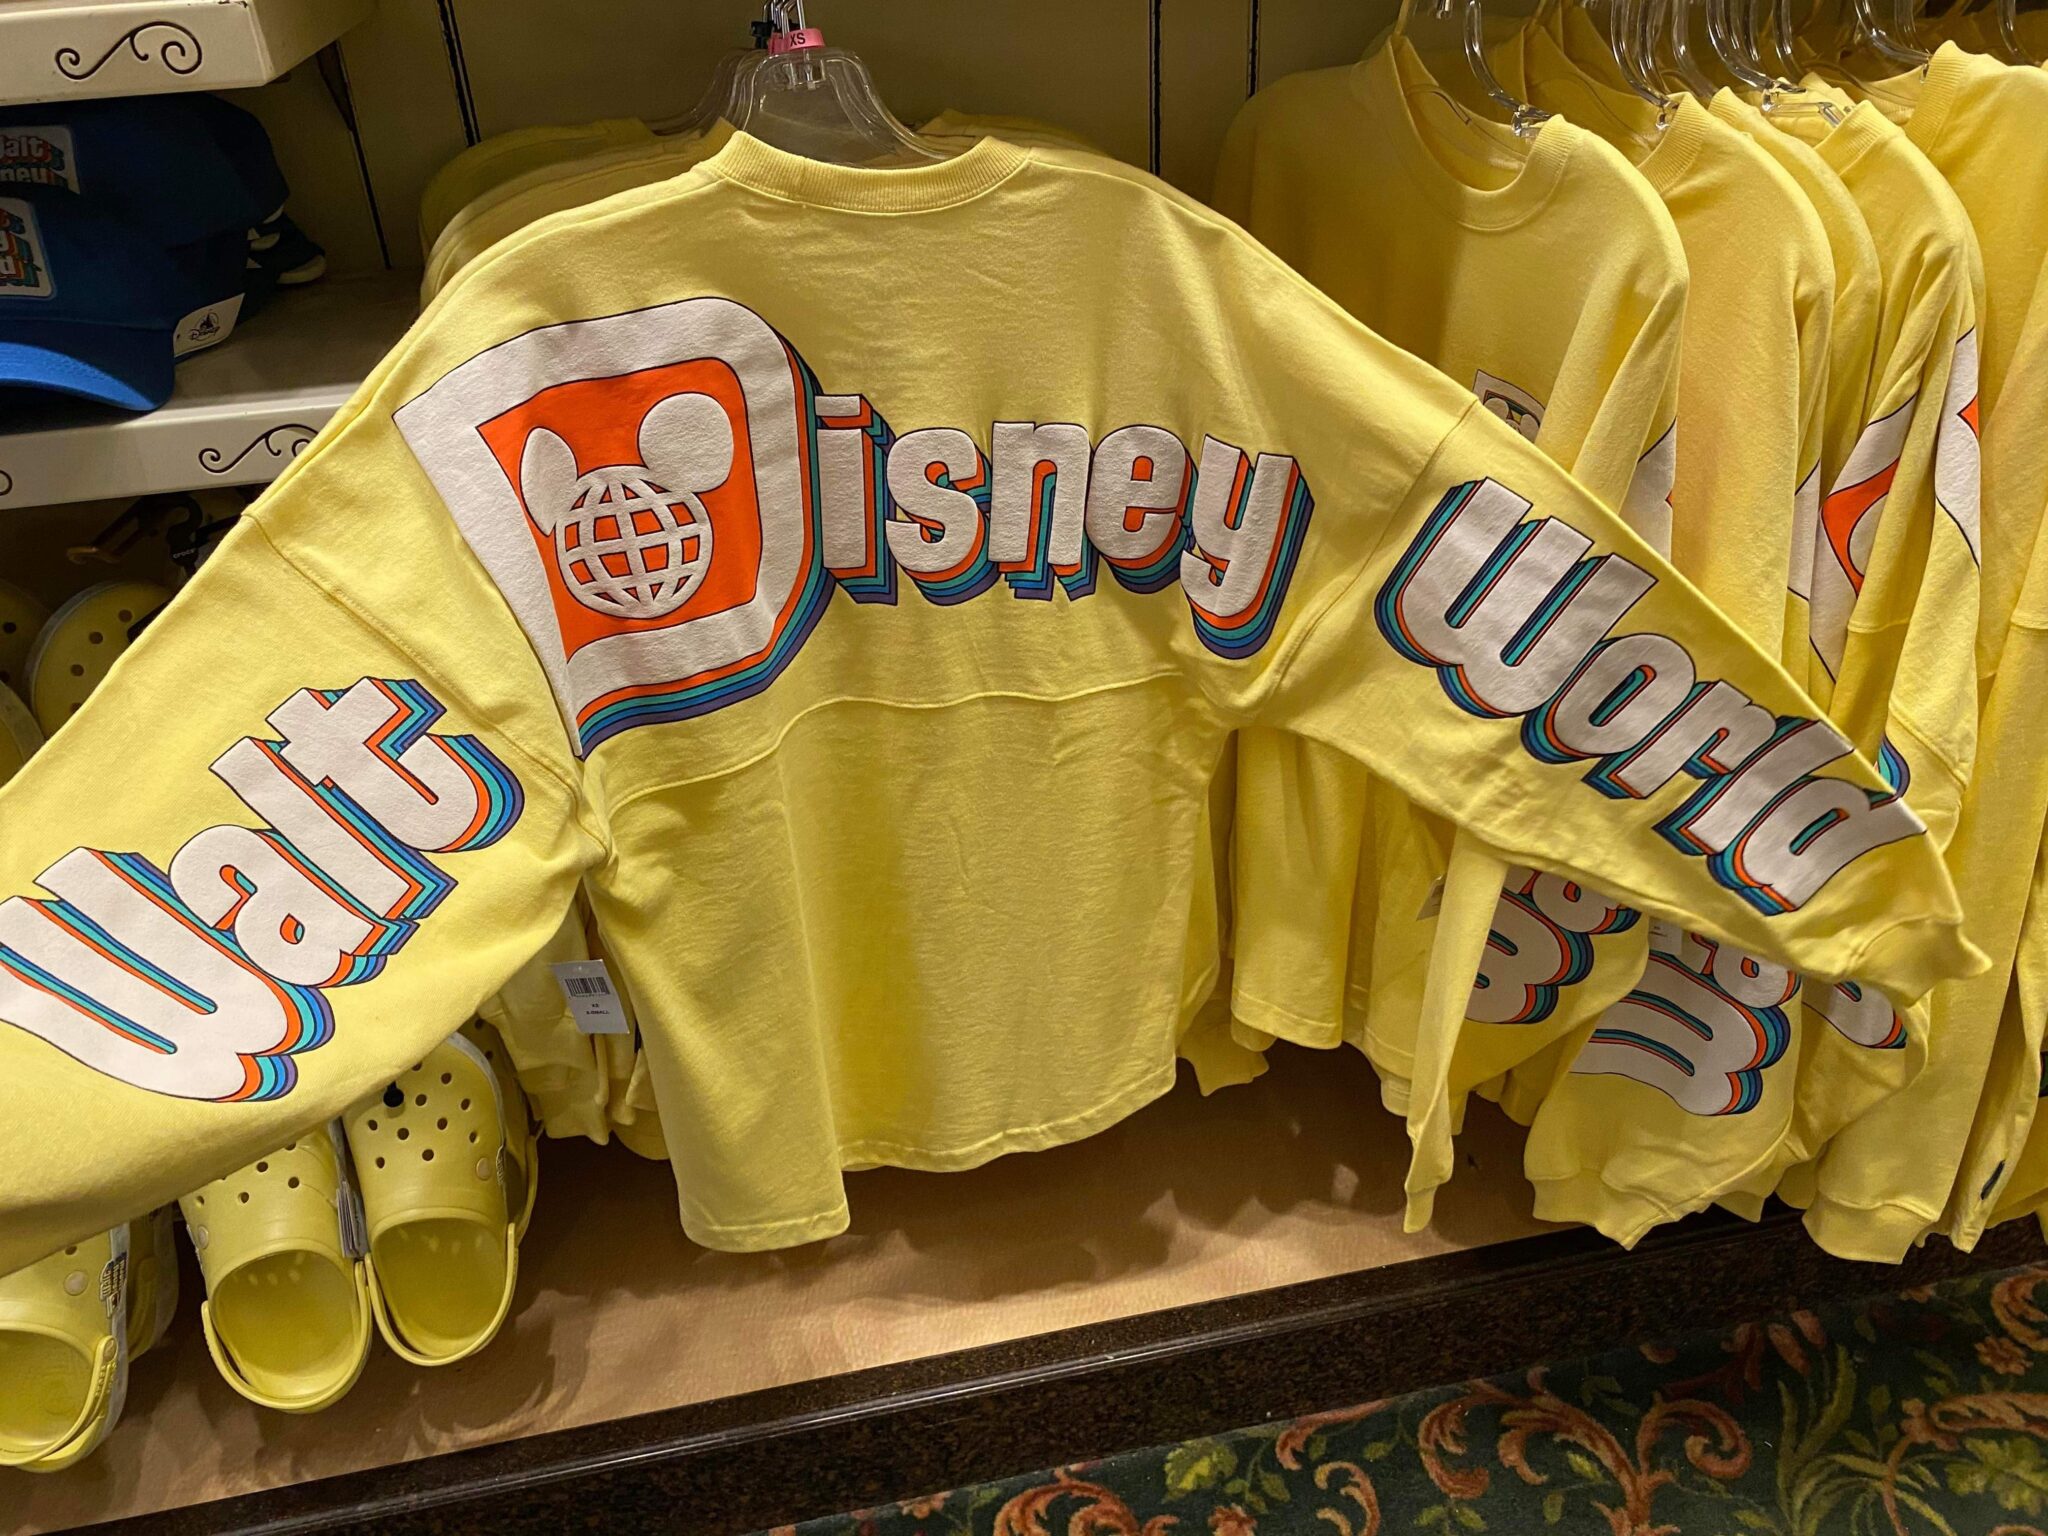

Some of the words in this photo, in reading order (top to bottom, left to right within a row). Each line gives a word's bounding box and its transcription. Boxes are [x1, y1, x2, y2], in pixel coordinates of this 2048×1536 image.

[790, 32, 806, 47] XS
[0, 136, 52, 163] alt
[0, 676, 524, 1102] Walt
[393, 297, 1312, 758] Disney
[1374, 477, 1927, 916] World
